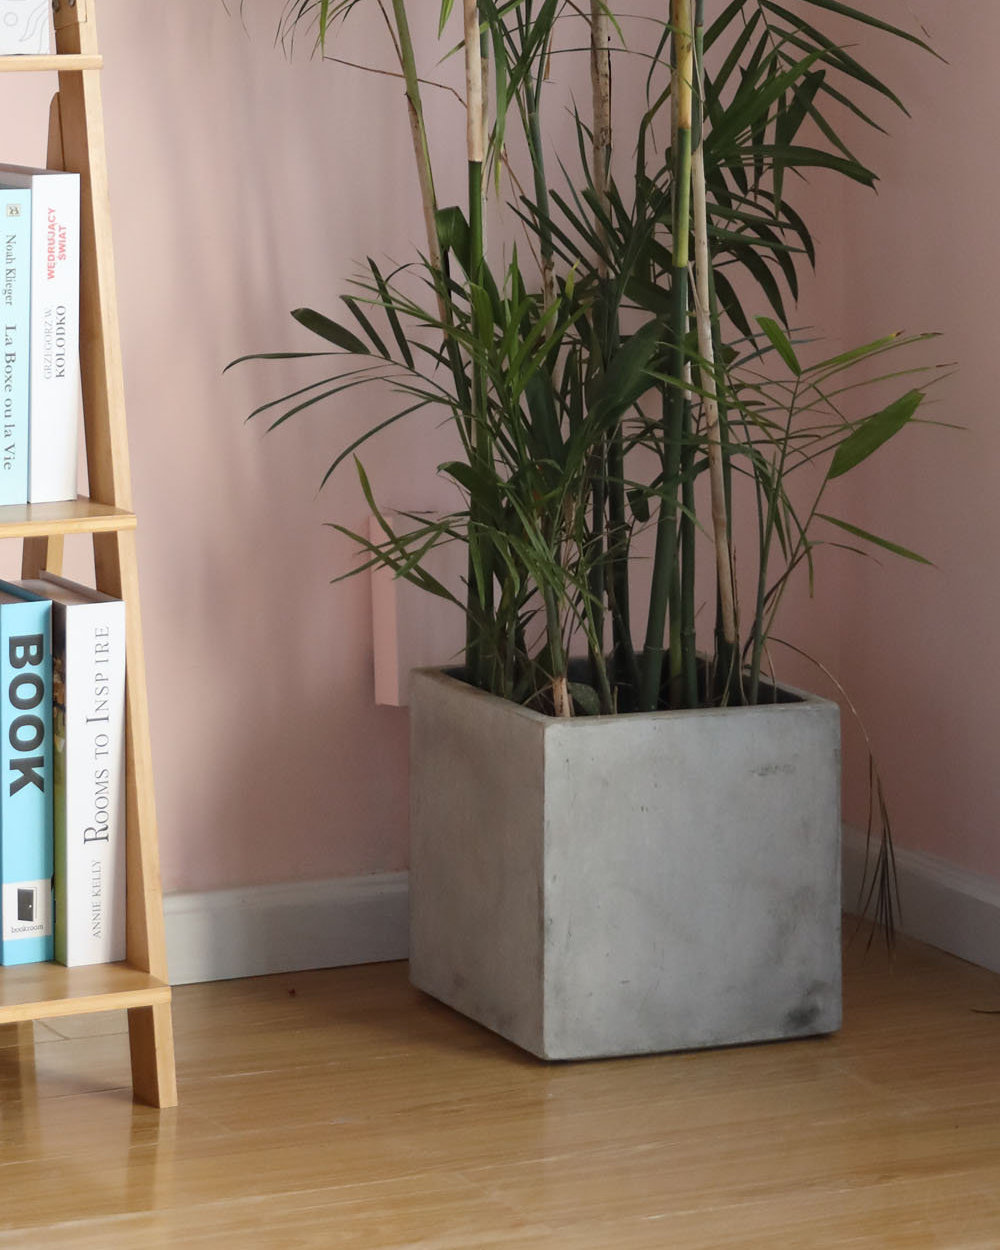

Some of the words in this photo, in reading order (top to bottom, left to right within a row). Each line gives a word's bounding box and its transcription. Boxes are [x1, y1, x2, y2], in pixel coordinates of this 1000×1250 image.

[5, 234, 16, 265] Noah
[3, 268, 16, 306] Klieger
[5, 325, 16, 346] La
[4, 352, 16, 392] Boxe
[4, 398, 13, 418] ou
[4, 424, 15, 438] la
[3, 443, 15, 470] Vie
[8, 633, 45, 797] BOOK
[94, 734, 110, 759] TO
[91, 860, 102, 898] KELLY
[10, 924, 44, 934] bookroom
[92, 901, 102, 938] ANNIE
